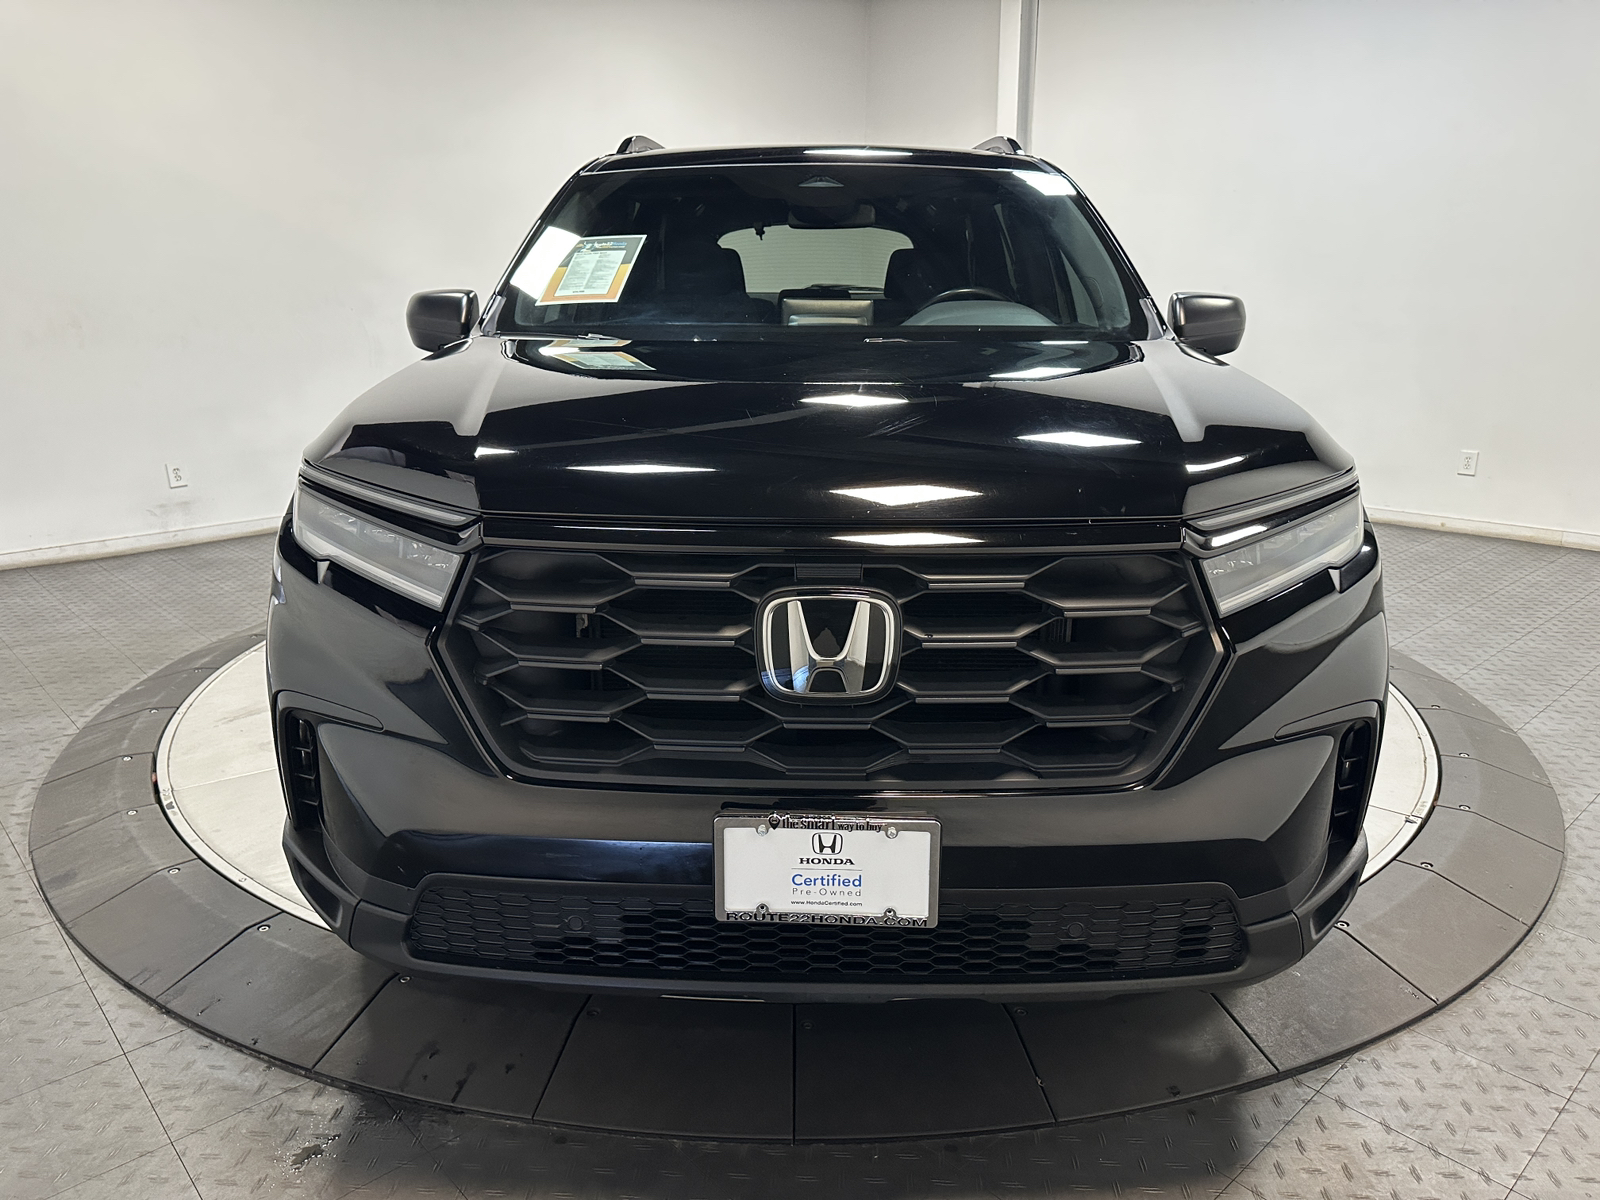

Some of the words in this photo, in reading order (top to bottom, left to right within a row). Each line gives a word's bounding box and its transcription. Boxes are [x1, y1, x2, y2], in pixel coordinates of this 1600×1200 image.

[800, 814, 835, 830] smart
[837, 823, 854, 832] way
[856, 820, 865, 830] to
[867, 818, 883, 833] buy
[799, 857, 855, 865] HONDA
[791, 873, 862, 887] Certified
[792, 887, 861, 897] Pre-Owned
[726, 912, 928, 928] ROUTE22HONDA.COM
